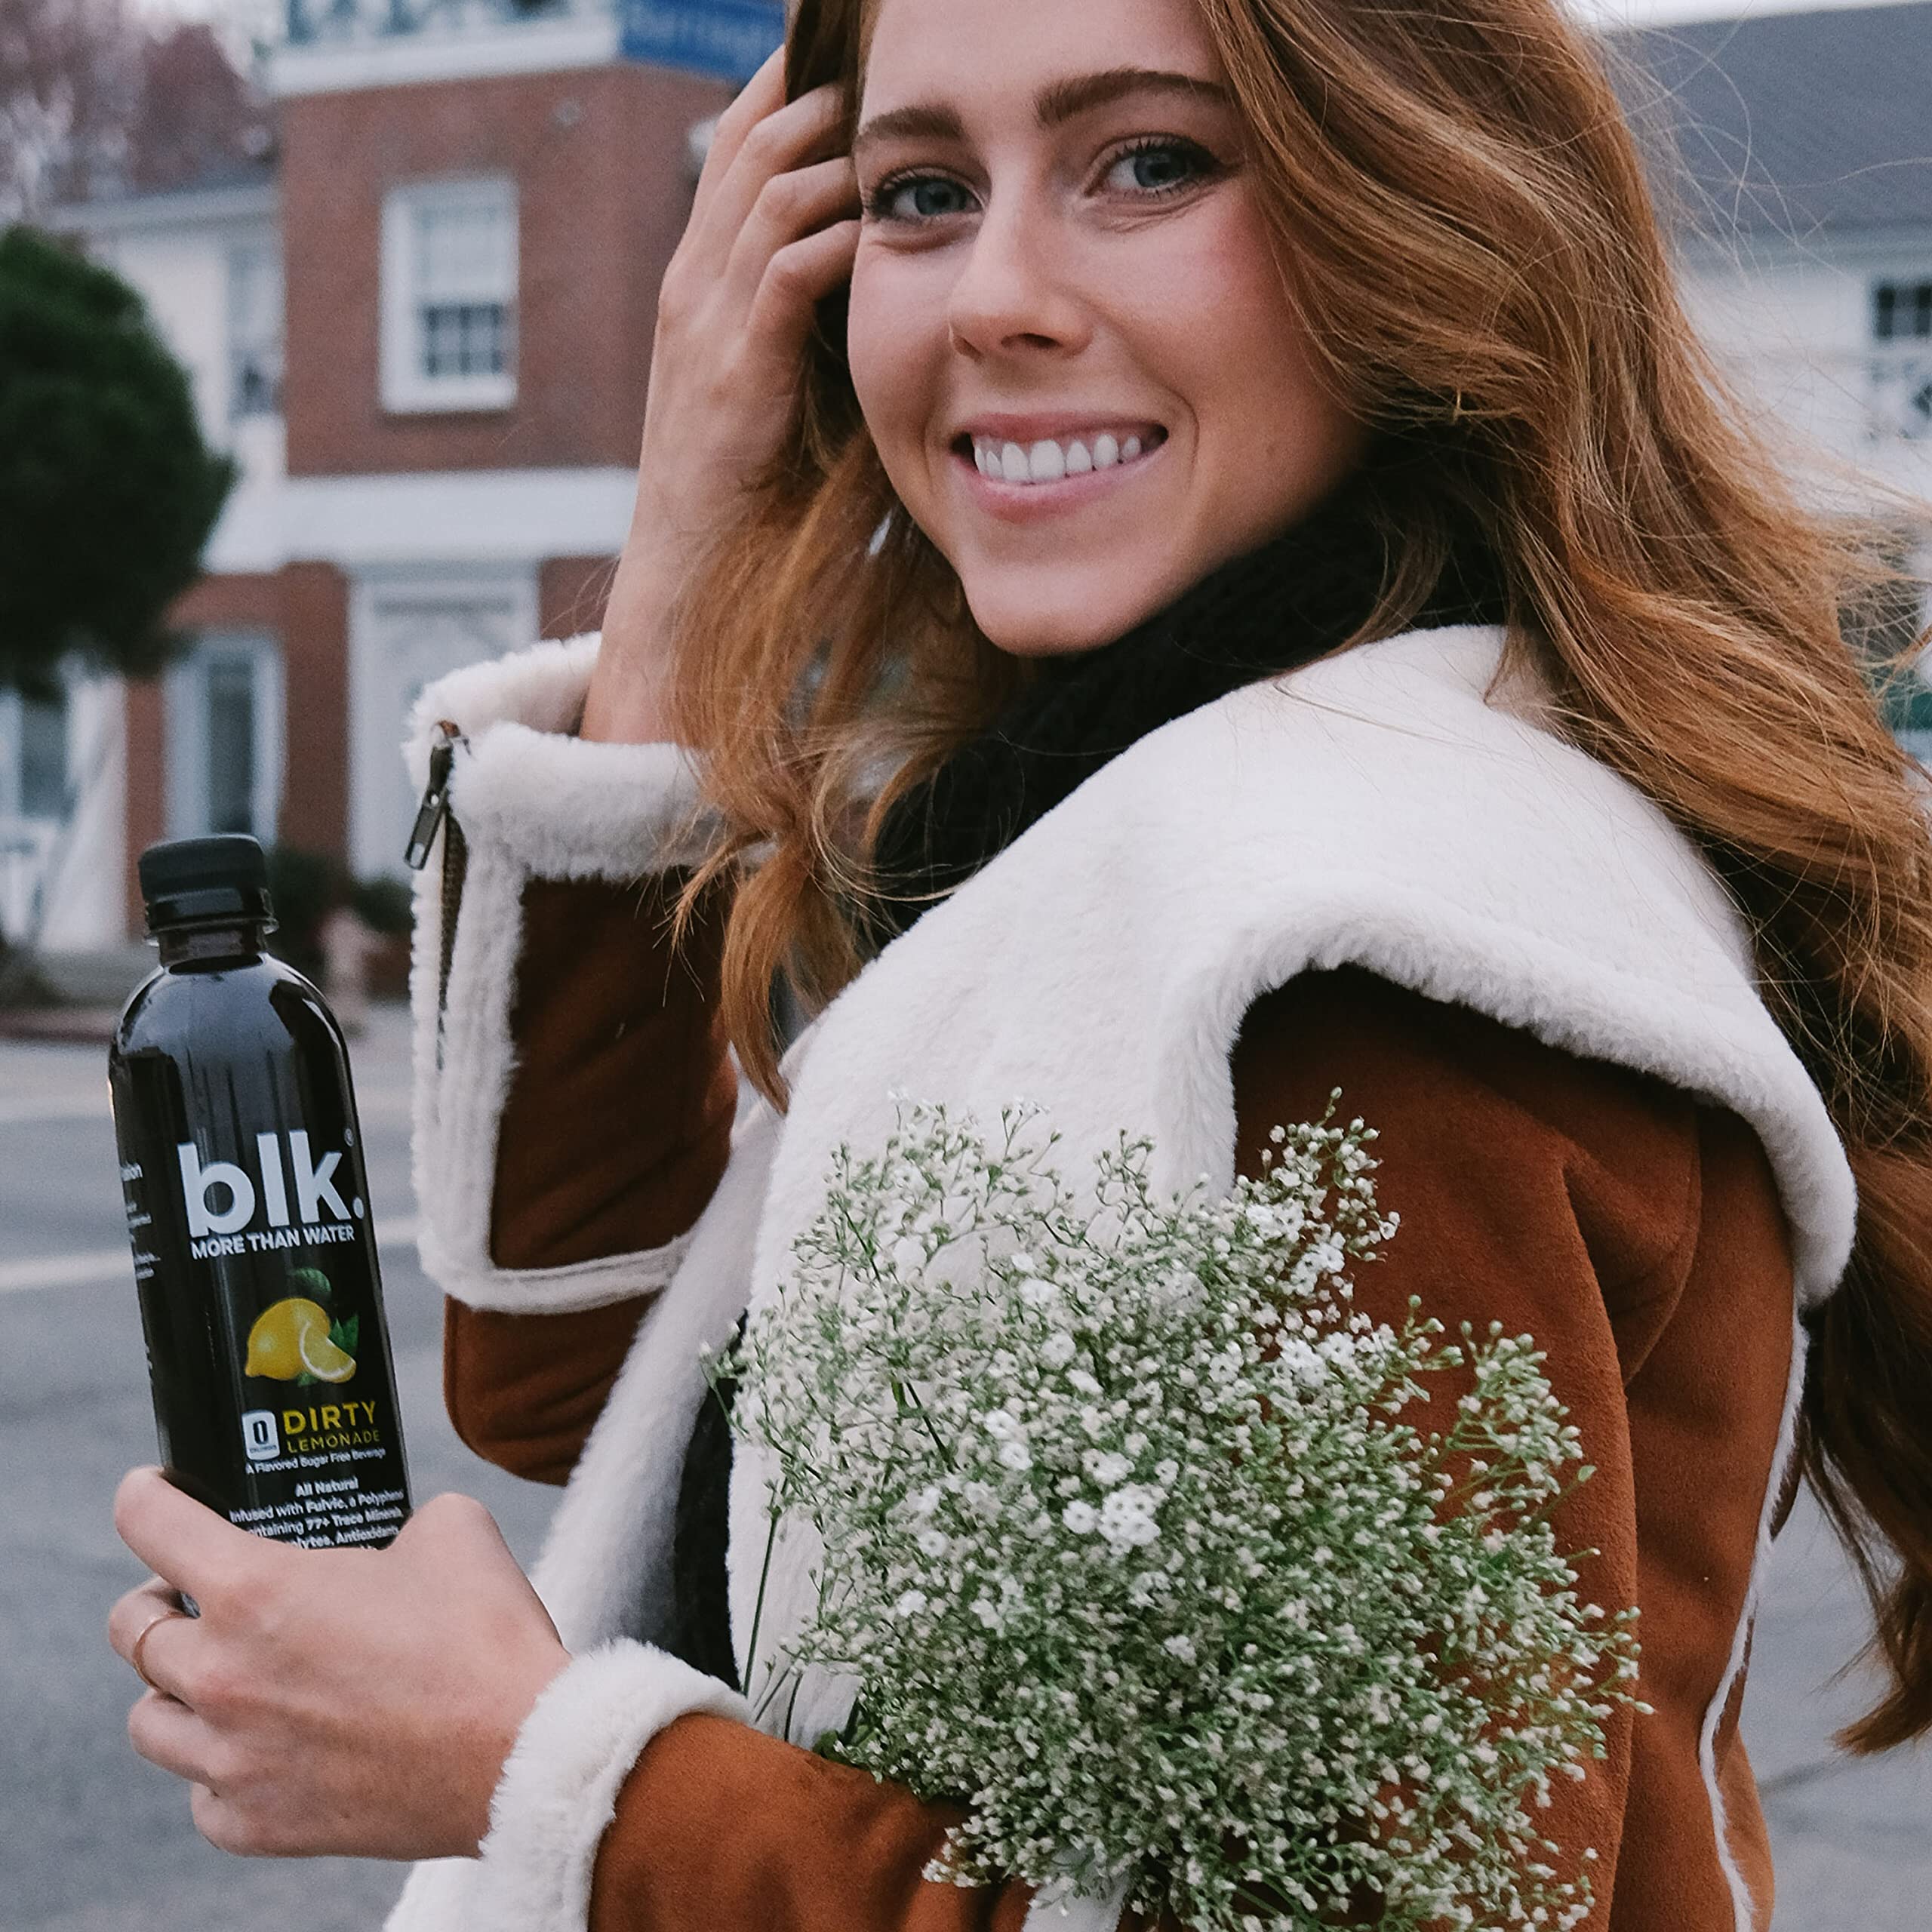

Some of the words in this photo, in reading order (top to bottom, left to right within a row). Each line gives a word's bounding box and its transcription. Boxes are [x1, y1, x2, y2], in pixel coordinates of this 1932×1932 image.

[177, 1129, 365, 1238] blk.
[190, 1235, 245, 1260] MORE
[247, 1229, 300, 1252] THAN
[303, 1225, 355, 1245] WATER
[281, 1401, 376, 1435] DIRTY
[287, 1430, 380, 1453] LEMONADE
[245, 1463, 255, 1475] A
[254, 1457, 299, 1473] Flavored
[299, 1454, 329, 1469] Sugar
[330, 1451, 351, 1463] Free
[295, 1482, 312, 1497] All
[314, 1475, 358, 1495] Natural
[229, 1504, 274, 1523] Infused
[276, 1502, 304, 1518] with
[306, 1516, 330, 1531] 77+
[331, 1512, 364, 1527] Trace
